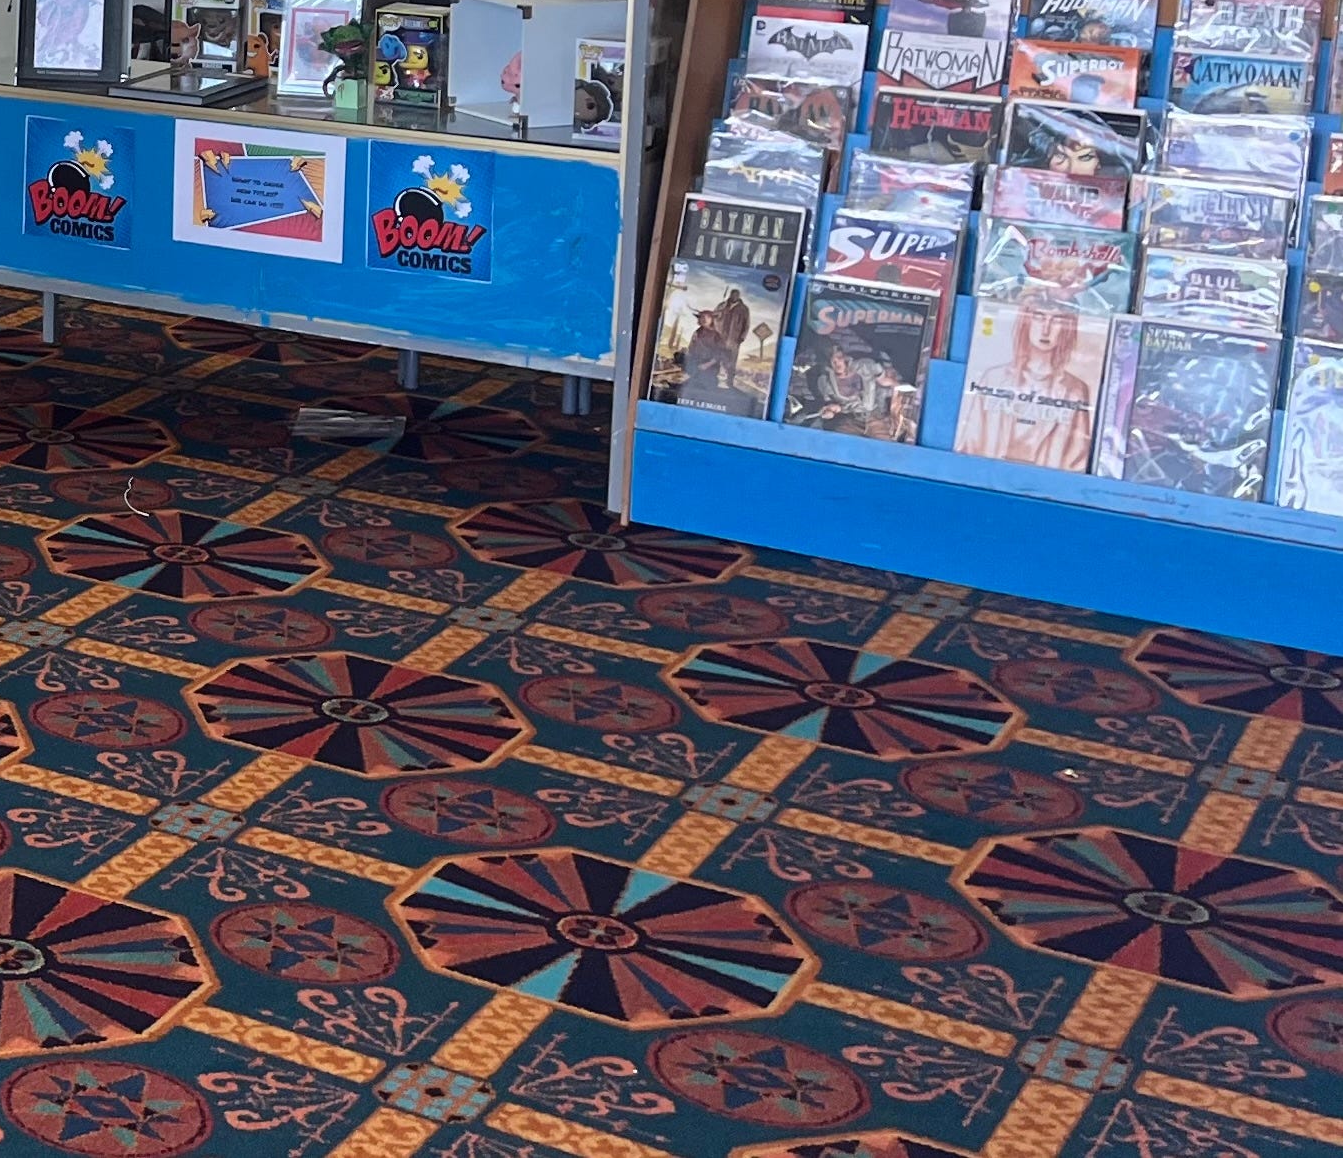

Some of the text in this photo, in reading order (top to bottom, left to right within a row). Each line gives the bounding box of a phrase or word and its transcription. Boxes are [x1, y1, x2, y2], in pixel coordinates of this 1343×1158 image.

[775, 28, 854, 52] BATMAN
[882, 31, 1002, 89] BATWOMAN
[1190, 56, 1303, 89] CATWOMAN
[890, 96, 993, 132] HITMAN
[28, 179, 127, 226] BOOM!
[49, 217, 115, 242] COMICS
[370, 206, 488, 256] BOOM!
[699, 207, 785, 240] BATMAN
[396, 249, 473, 275] COMICS
[817, 305, 925, 336] SUPERMAN
[1018, 390, 1036, 403] of
